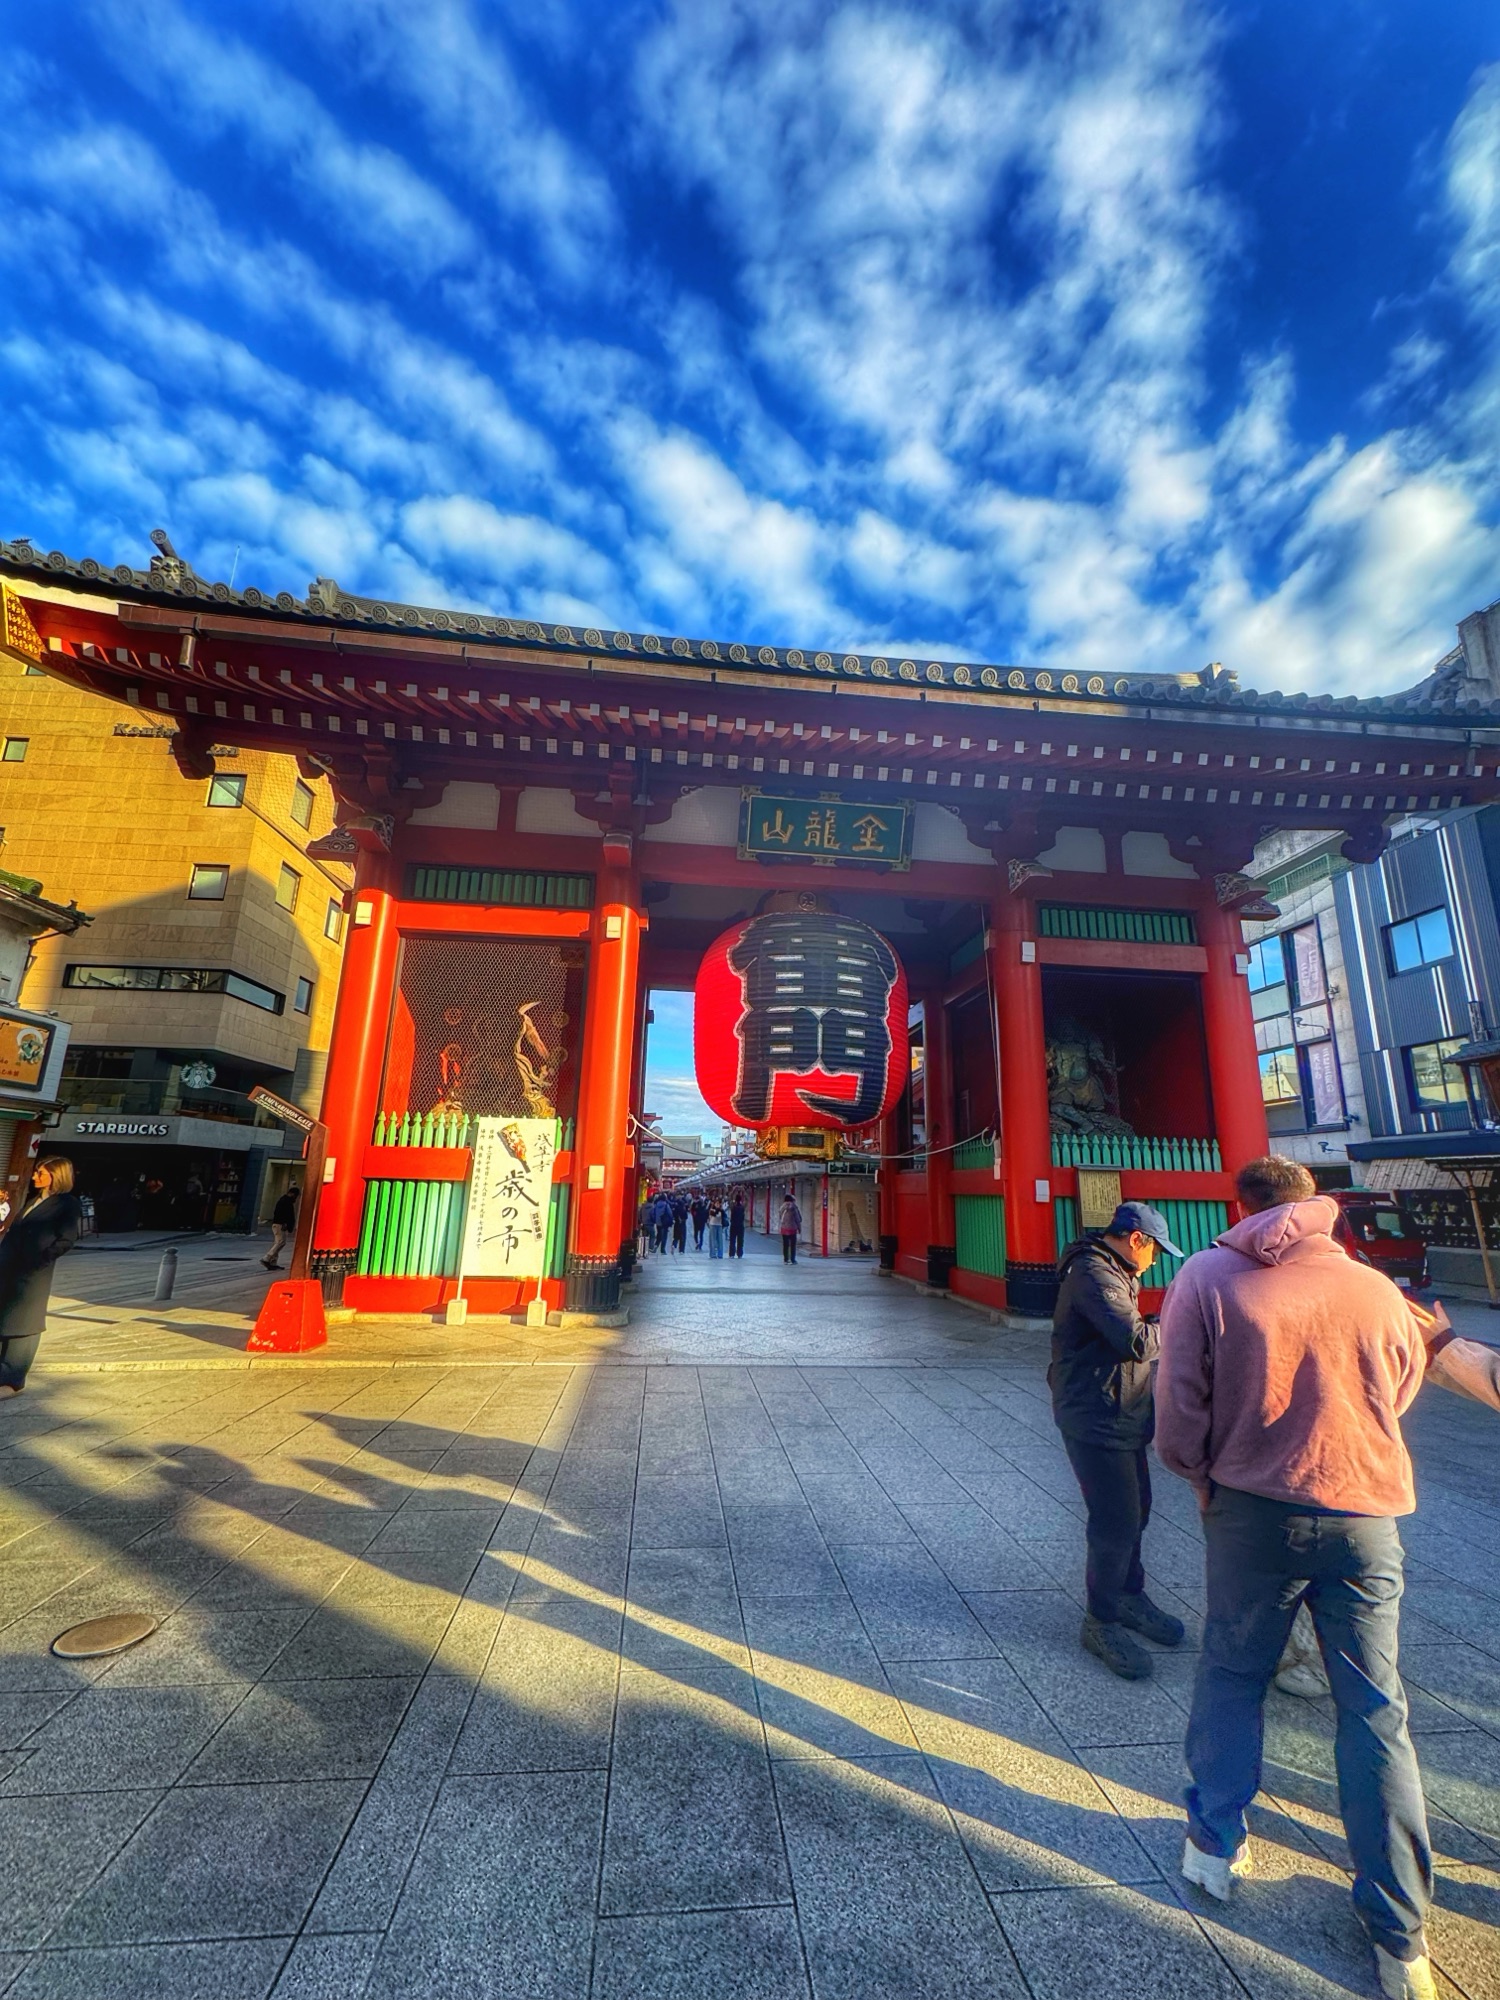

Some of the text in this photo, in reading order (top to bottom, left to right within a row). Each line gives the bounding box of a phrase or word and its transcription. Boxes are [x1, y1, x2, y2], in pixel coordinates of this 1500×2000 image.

[726, 912, 899, 1126] 雷門
[77, 1122, 169, 1136] STARBUCKS
[259, 1093, 299, 1119] KAMINARIMON
[297, 1115, 314, 1128] GATE
[532, 1133, 553, 1172] 浅草寺
[483, 1169, 540, 1264] 歳の市
